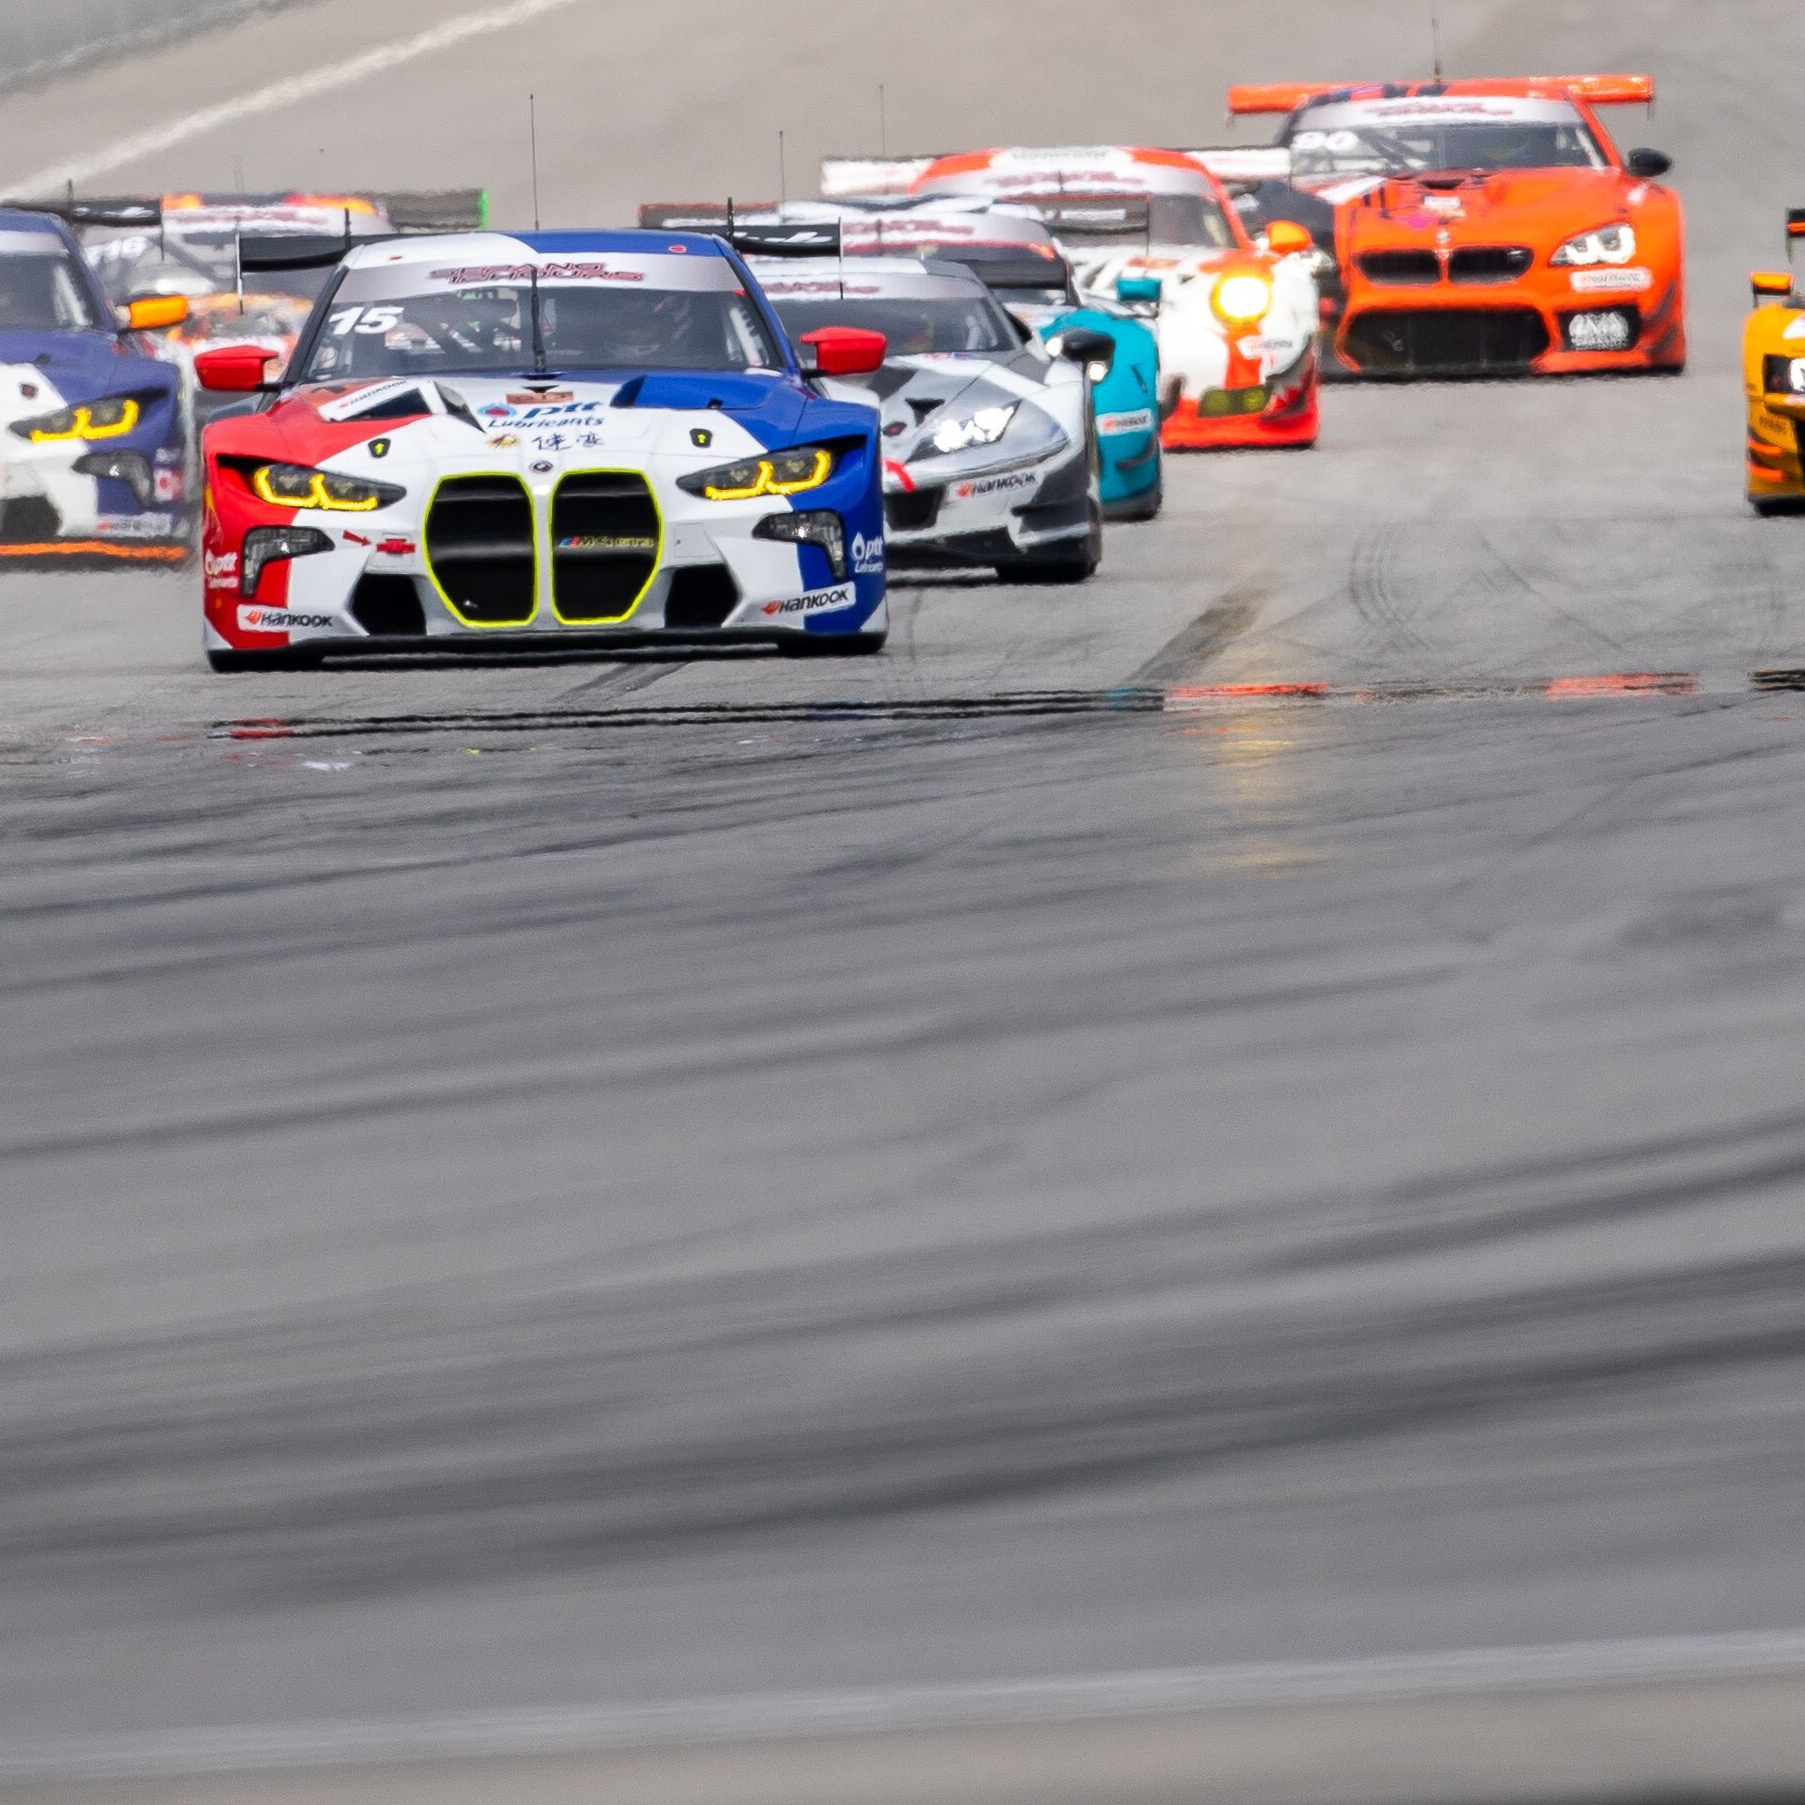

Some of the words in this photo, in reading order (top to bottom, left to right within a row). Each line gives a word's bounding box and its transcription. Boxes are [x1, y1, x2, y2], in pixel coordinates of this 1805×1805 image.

[328, 306, 404, 335] 15
[523, 401, 603, 419] ptt
[488, 415, 604, 429] Lubricants
